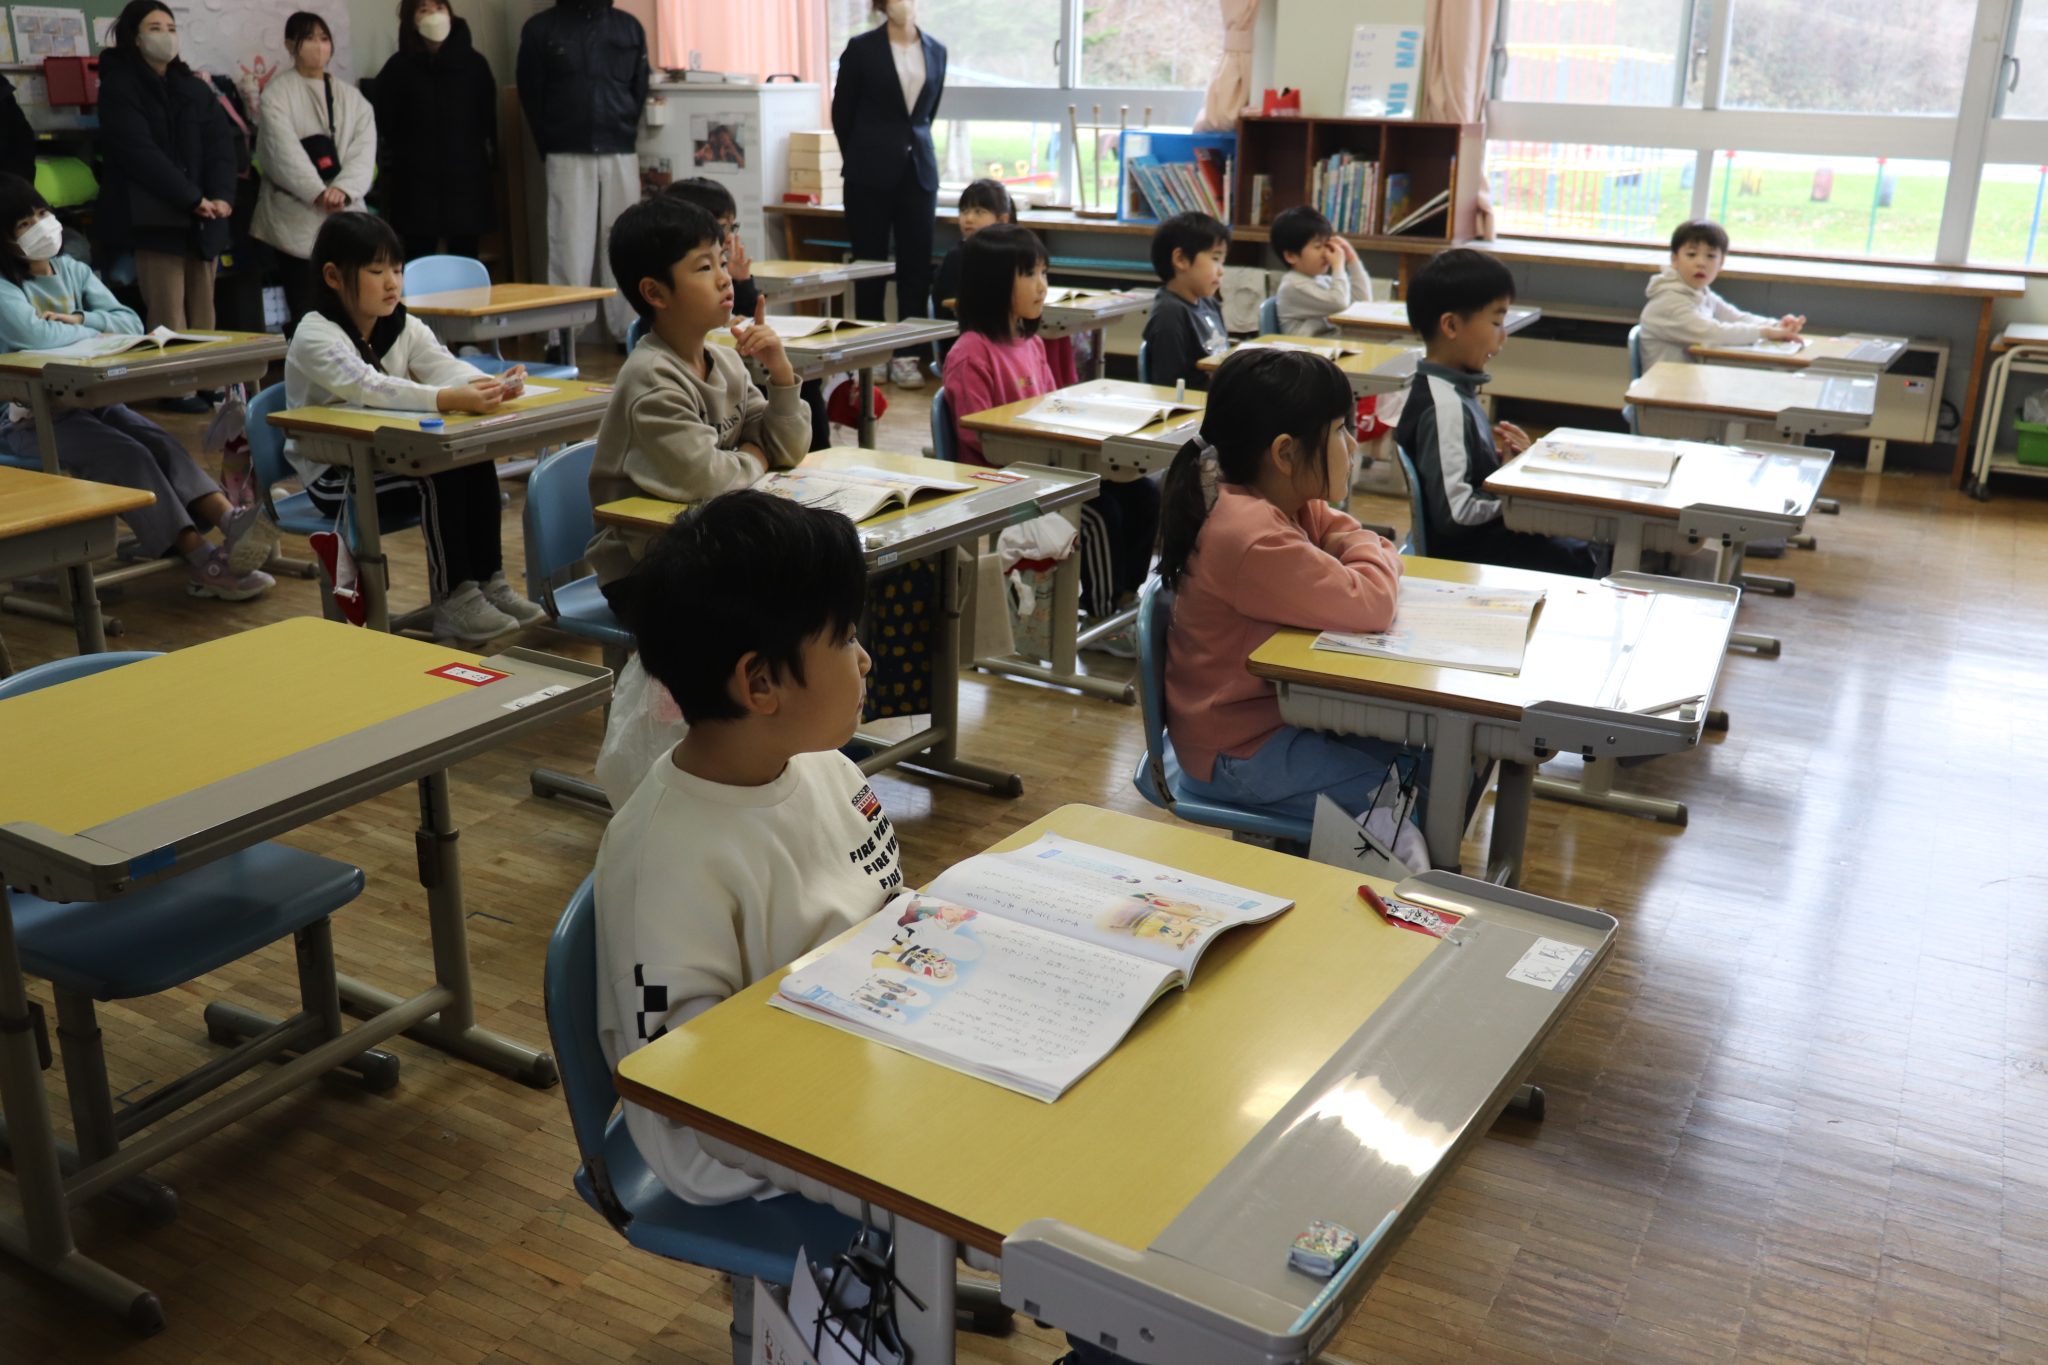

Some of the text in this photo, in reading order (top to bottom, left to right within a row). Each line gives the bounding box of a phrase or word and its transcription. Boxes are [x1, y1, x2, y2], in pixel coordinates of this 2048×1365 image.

[849, 836, 876, 863] FIRE
[863, 850, 890, 875] FIRE
[879, 867, 901, 889] FIRE
